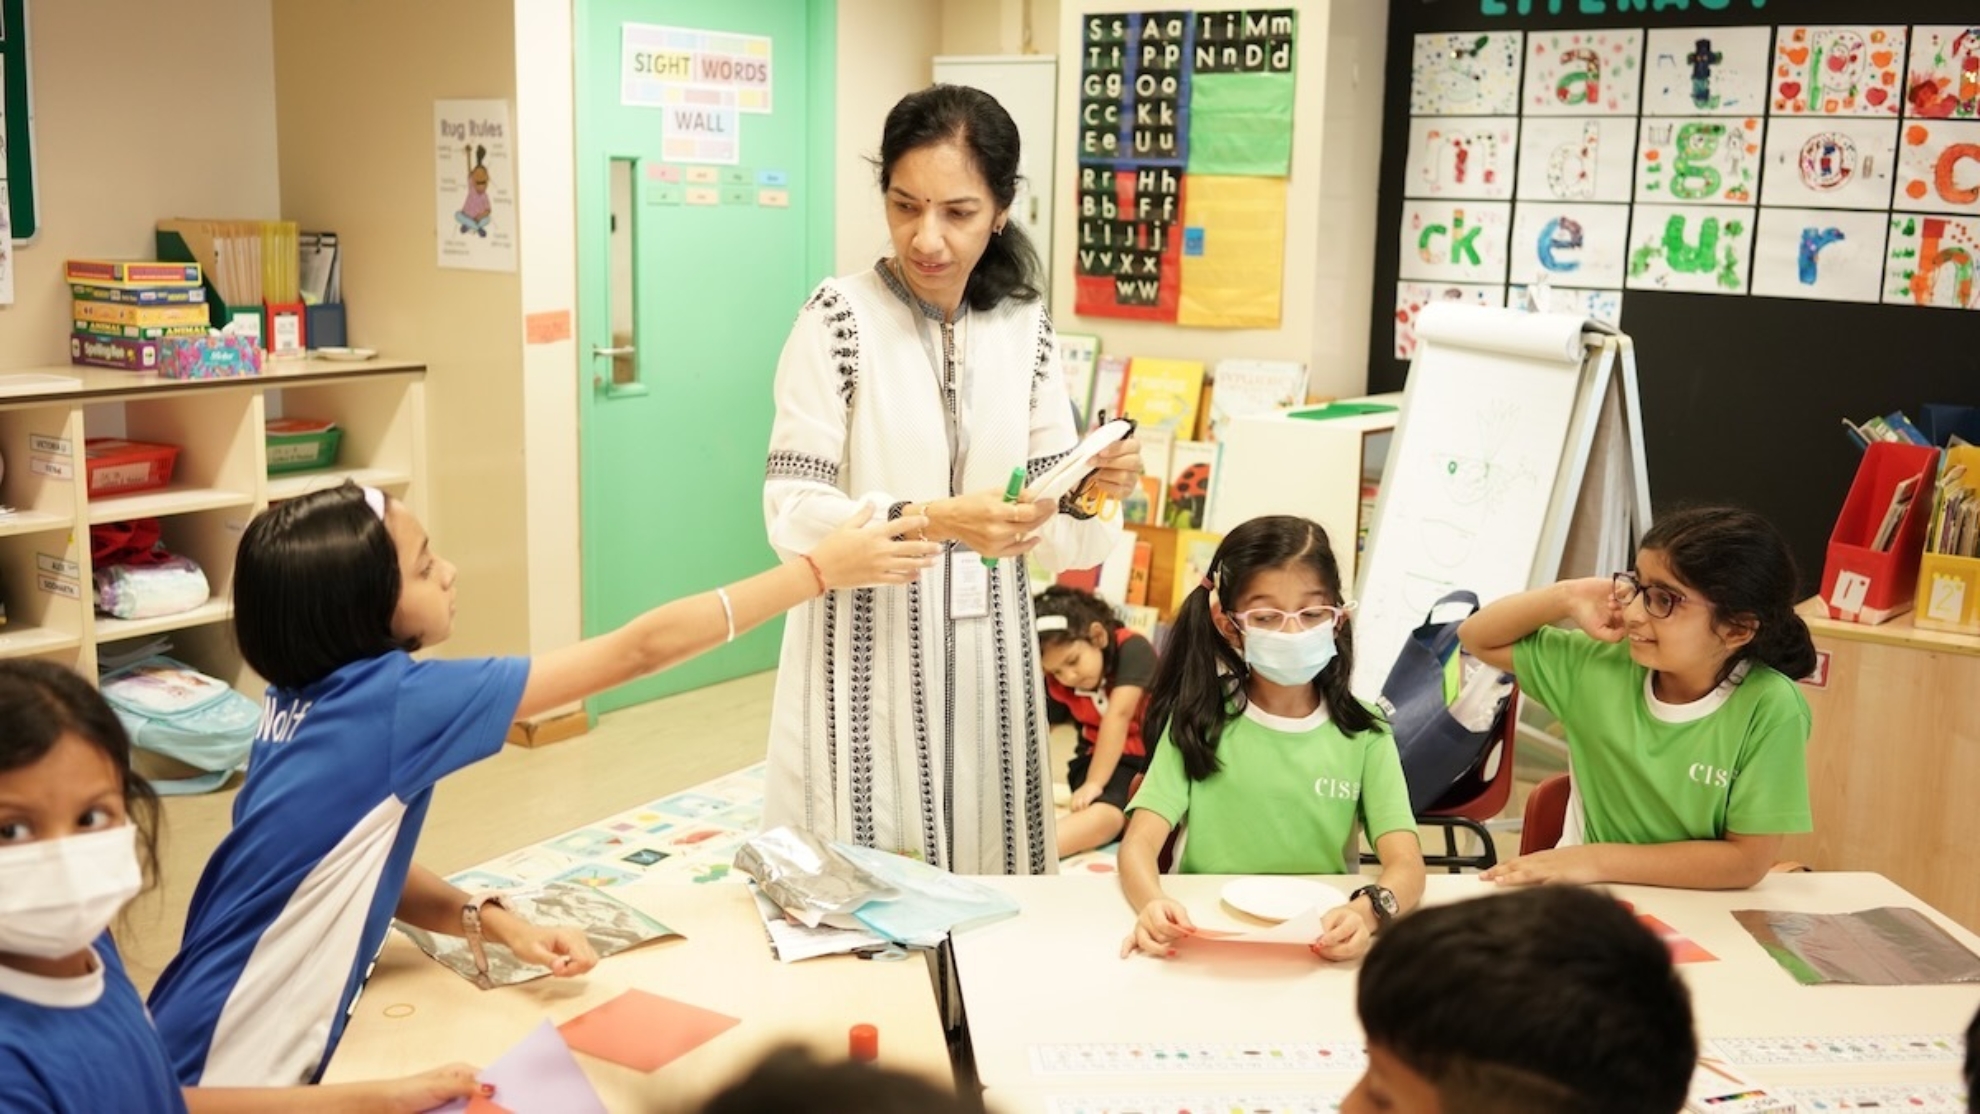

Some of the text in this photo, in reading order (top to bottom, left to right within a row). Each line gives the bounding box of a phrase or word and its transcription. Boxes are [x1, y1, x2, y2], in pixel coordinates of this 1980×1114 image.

[634, 52, 767, 83] SIGHT WORDS
[440, 118, 503, 141] Rug Rules
[675, 111, 725, 133] WALL
